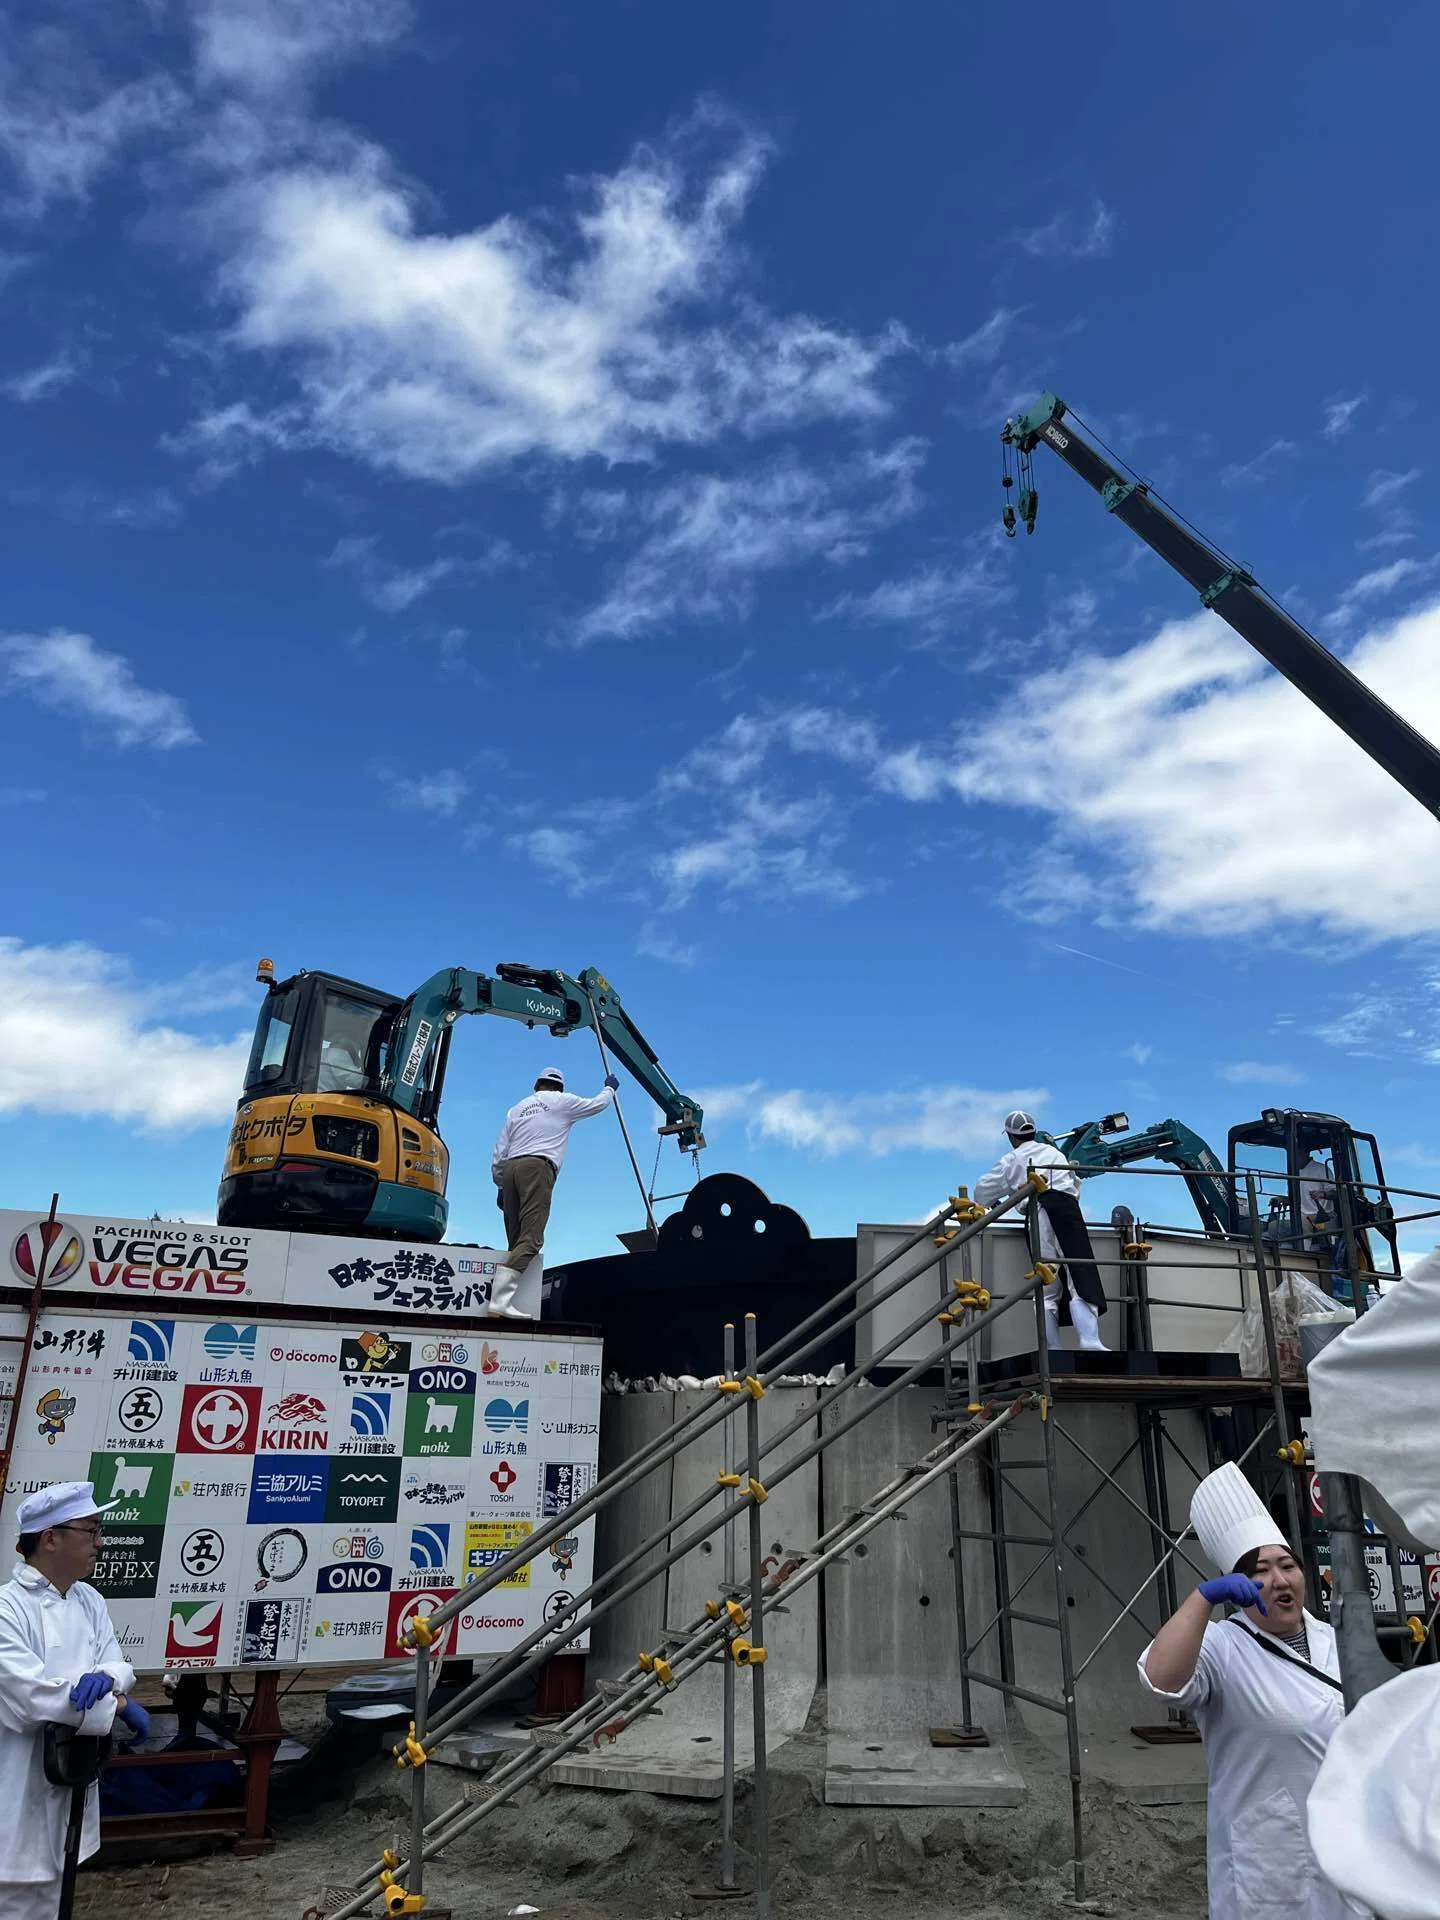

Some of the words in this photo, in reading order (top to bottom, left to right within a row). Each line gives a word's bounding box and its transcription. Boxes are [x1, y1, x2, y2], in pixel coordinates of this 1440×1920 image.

[526, 999, 562, 1017] Kubota
[94, 1225, 188, 1242] PACHINKO
[193, 1234, 204, 1243] &
[211, 1234, 252, 1247] SLOT
[92, 1237, 249, 1272] VEGAS
[328, 1250, 455, 1289] 日本一の芋煮会
[459, 1259, 504, 1275] 山形名
[88, 1261, 246, 1295] VEGAS
[286, 1351, 337, 1363] docomo
[113, 1369, 179, 1382] 升川建設
[200, 1368, 253, 1383] 山形丸魚
[559, 1363, 600, 1376] 荘内銀行
[343, 1374, 405, 1388] ヤマケン
[418, 1371, 468, 1390] ONO
[555, 1423, 599, 1435] 山形ガス
[260, 1430, 329, 1450] KIRIN
[482, 1440, 528, 1455] 山形丸魚
[339, 1442, 396, 1454] 升川建設
[192, 1482, 248, 1497] 荘内銀行
[256, 1474, 323, 1492] 三協アルミ
[265, 1494, 311, 1503] SankyoAlumi
[340, 1496, 386, 1507] TOYOPET
[489, 1494, 514, 1503] TOSOH
[102, 1551, 137, 1560] 株式会社
[329, 1568, 381, 1588] ONO
[398, 1575, 455, 1589] 升川建設
[281, 1603, 292, 1641] 米沢牛
[332, 1621, 384, 1637] 荘内銀行
[476, 1616, 524, 1629] docomo
[259, 1603, 280, 1660] 登起波
